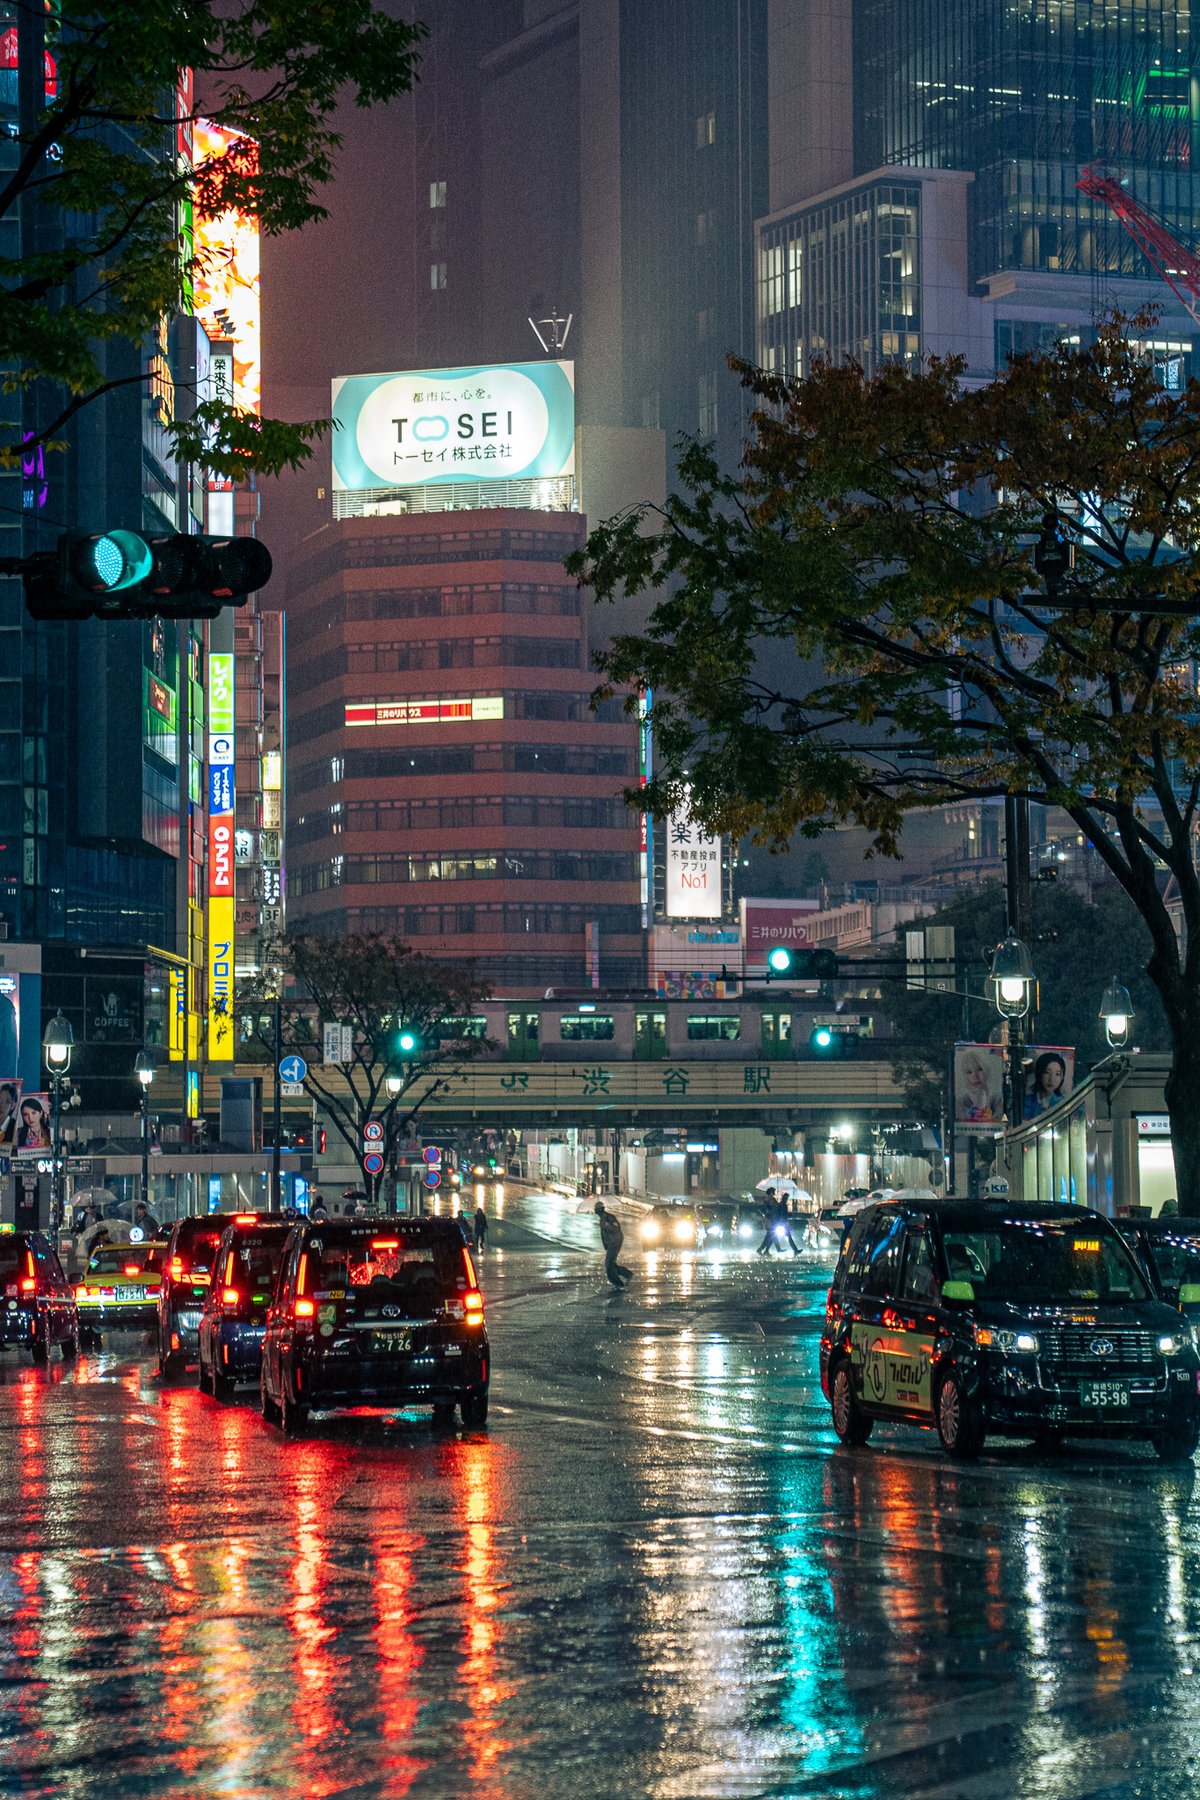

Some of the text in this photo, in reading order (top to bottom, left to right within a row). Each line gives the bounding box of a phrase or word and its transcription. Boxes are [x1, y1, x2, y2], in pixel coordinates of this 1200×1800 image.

[412, 388, 493, 404] 都市に、心を。
[391, 410, 513, 444] TOSEI
[392, 443, 513, 466] トーセイ株式会社
[213, 660, 228, 701] レイク
[376, 707, 421, 720] 三井のリハウス
[671, 850, 717, 861] 不動産投資
[214, 843, 230, 886] アコム
[681, 862, 707, 872] アプリ
[265, 909, 279, 920] 3F
[94, 1018, 130, 1027] COFFEE
[501, 1066, 771, 1094] JR 渋谷駅
[1107, 1382, 1121, 1391] 510
[1091, 1391, 1128, 1406] 55-98
